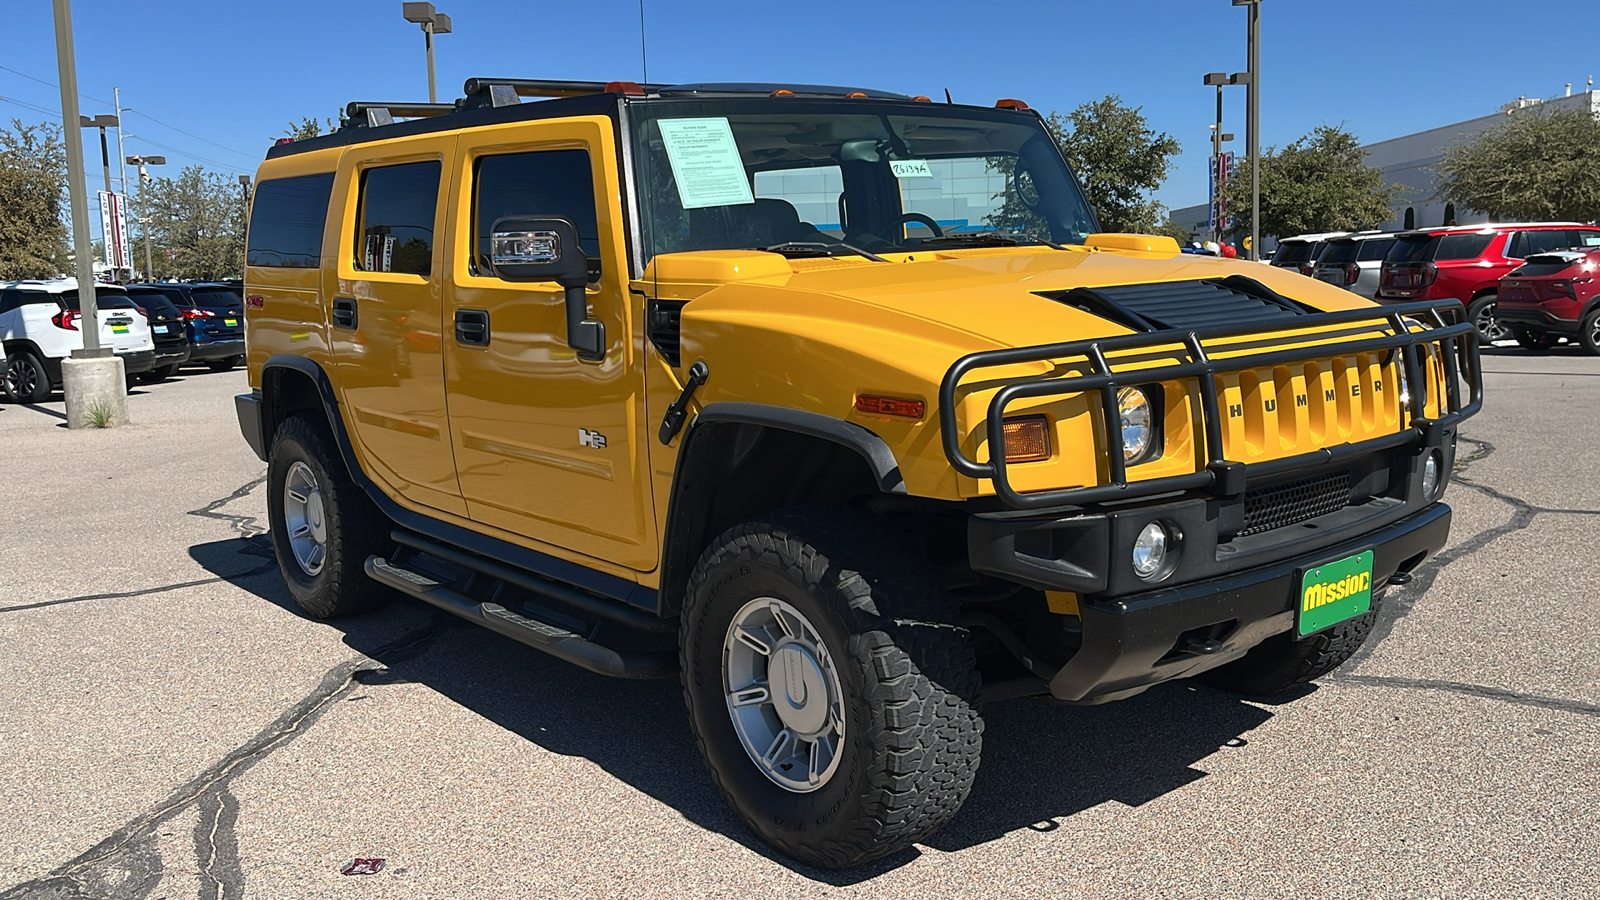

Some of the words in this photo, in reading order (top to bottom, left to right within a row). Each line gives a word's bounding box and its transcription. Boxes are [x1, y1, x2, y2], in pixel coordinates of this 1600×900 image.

[1230, 380, 1382, 417] HUMMER
[579, 428, 607, 449] H2
[1303, 571, 1370, 612] Mission
